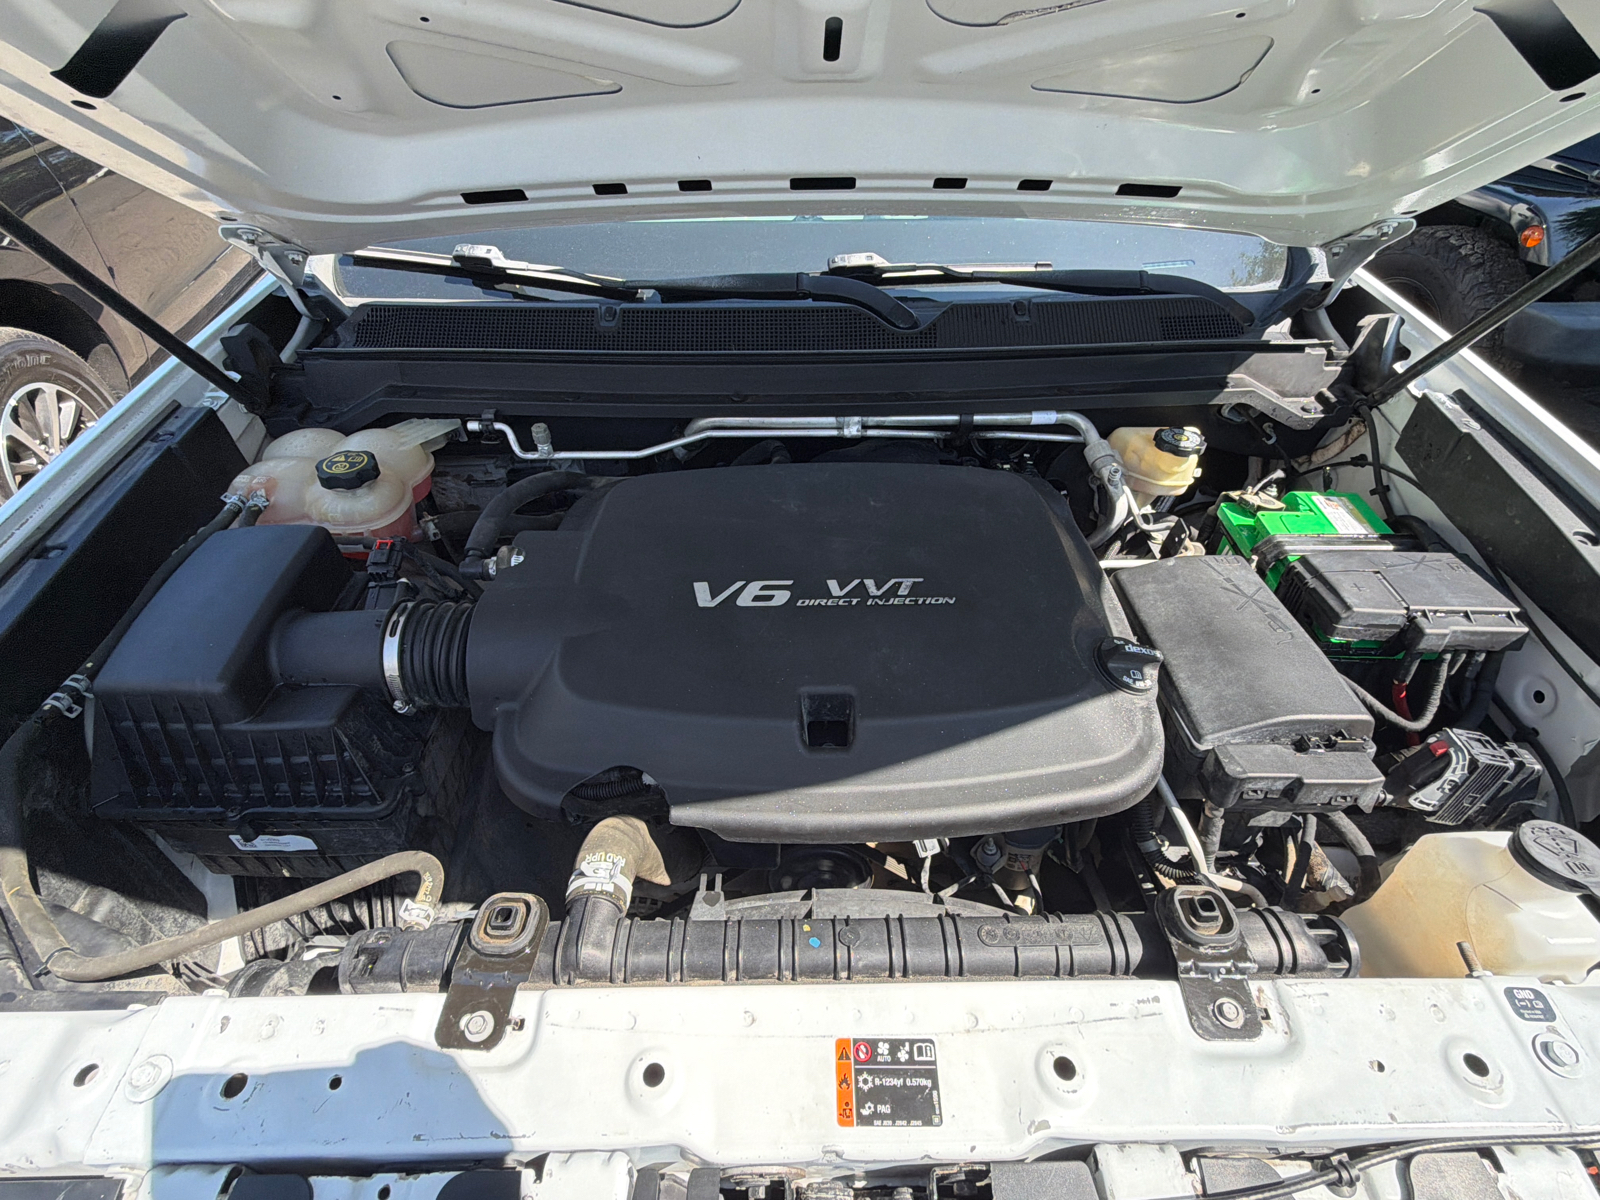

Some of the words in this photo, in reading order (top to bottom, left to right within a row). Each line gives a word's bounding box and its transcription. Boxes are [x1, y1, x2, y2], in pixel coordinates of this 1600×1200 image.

[693, 580, 794, 607] V6
[826, 578, 924, 597] VVT
[796, 598, 861, 606] DIRECT
[866, 596, 956, 606] INJECTION
[586, 852, 605, 862] UPR
[1513, 989, 1535, 999] GND
[875, 1078, 904, 1087] R-1234yf
[906, 1078, 932, 1087] 0.570kg
[877, 1105, 891, 1114] PAG
